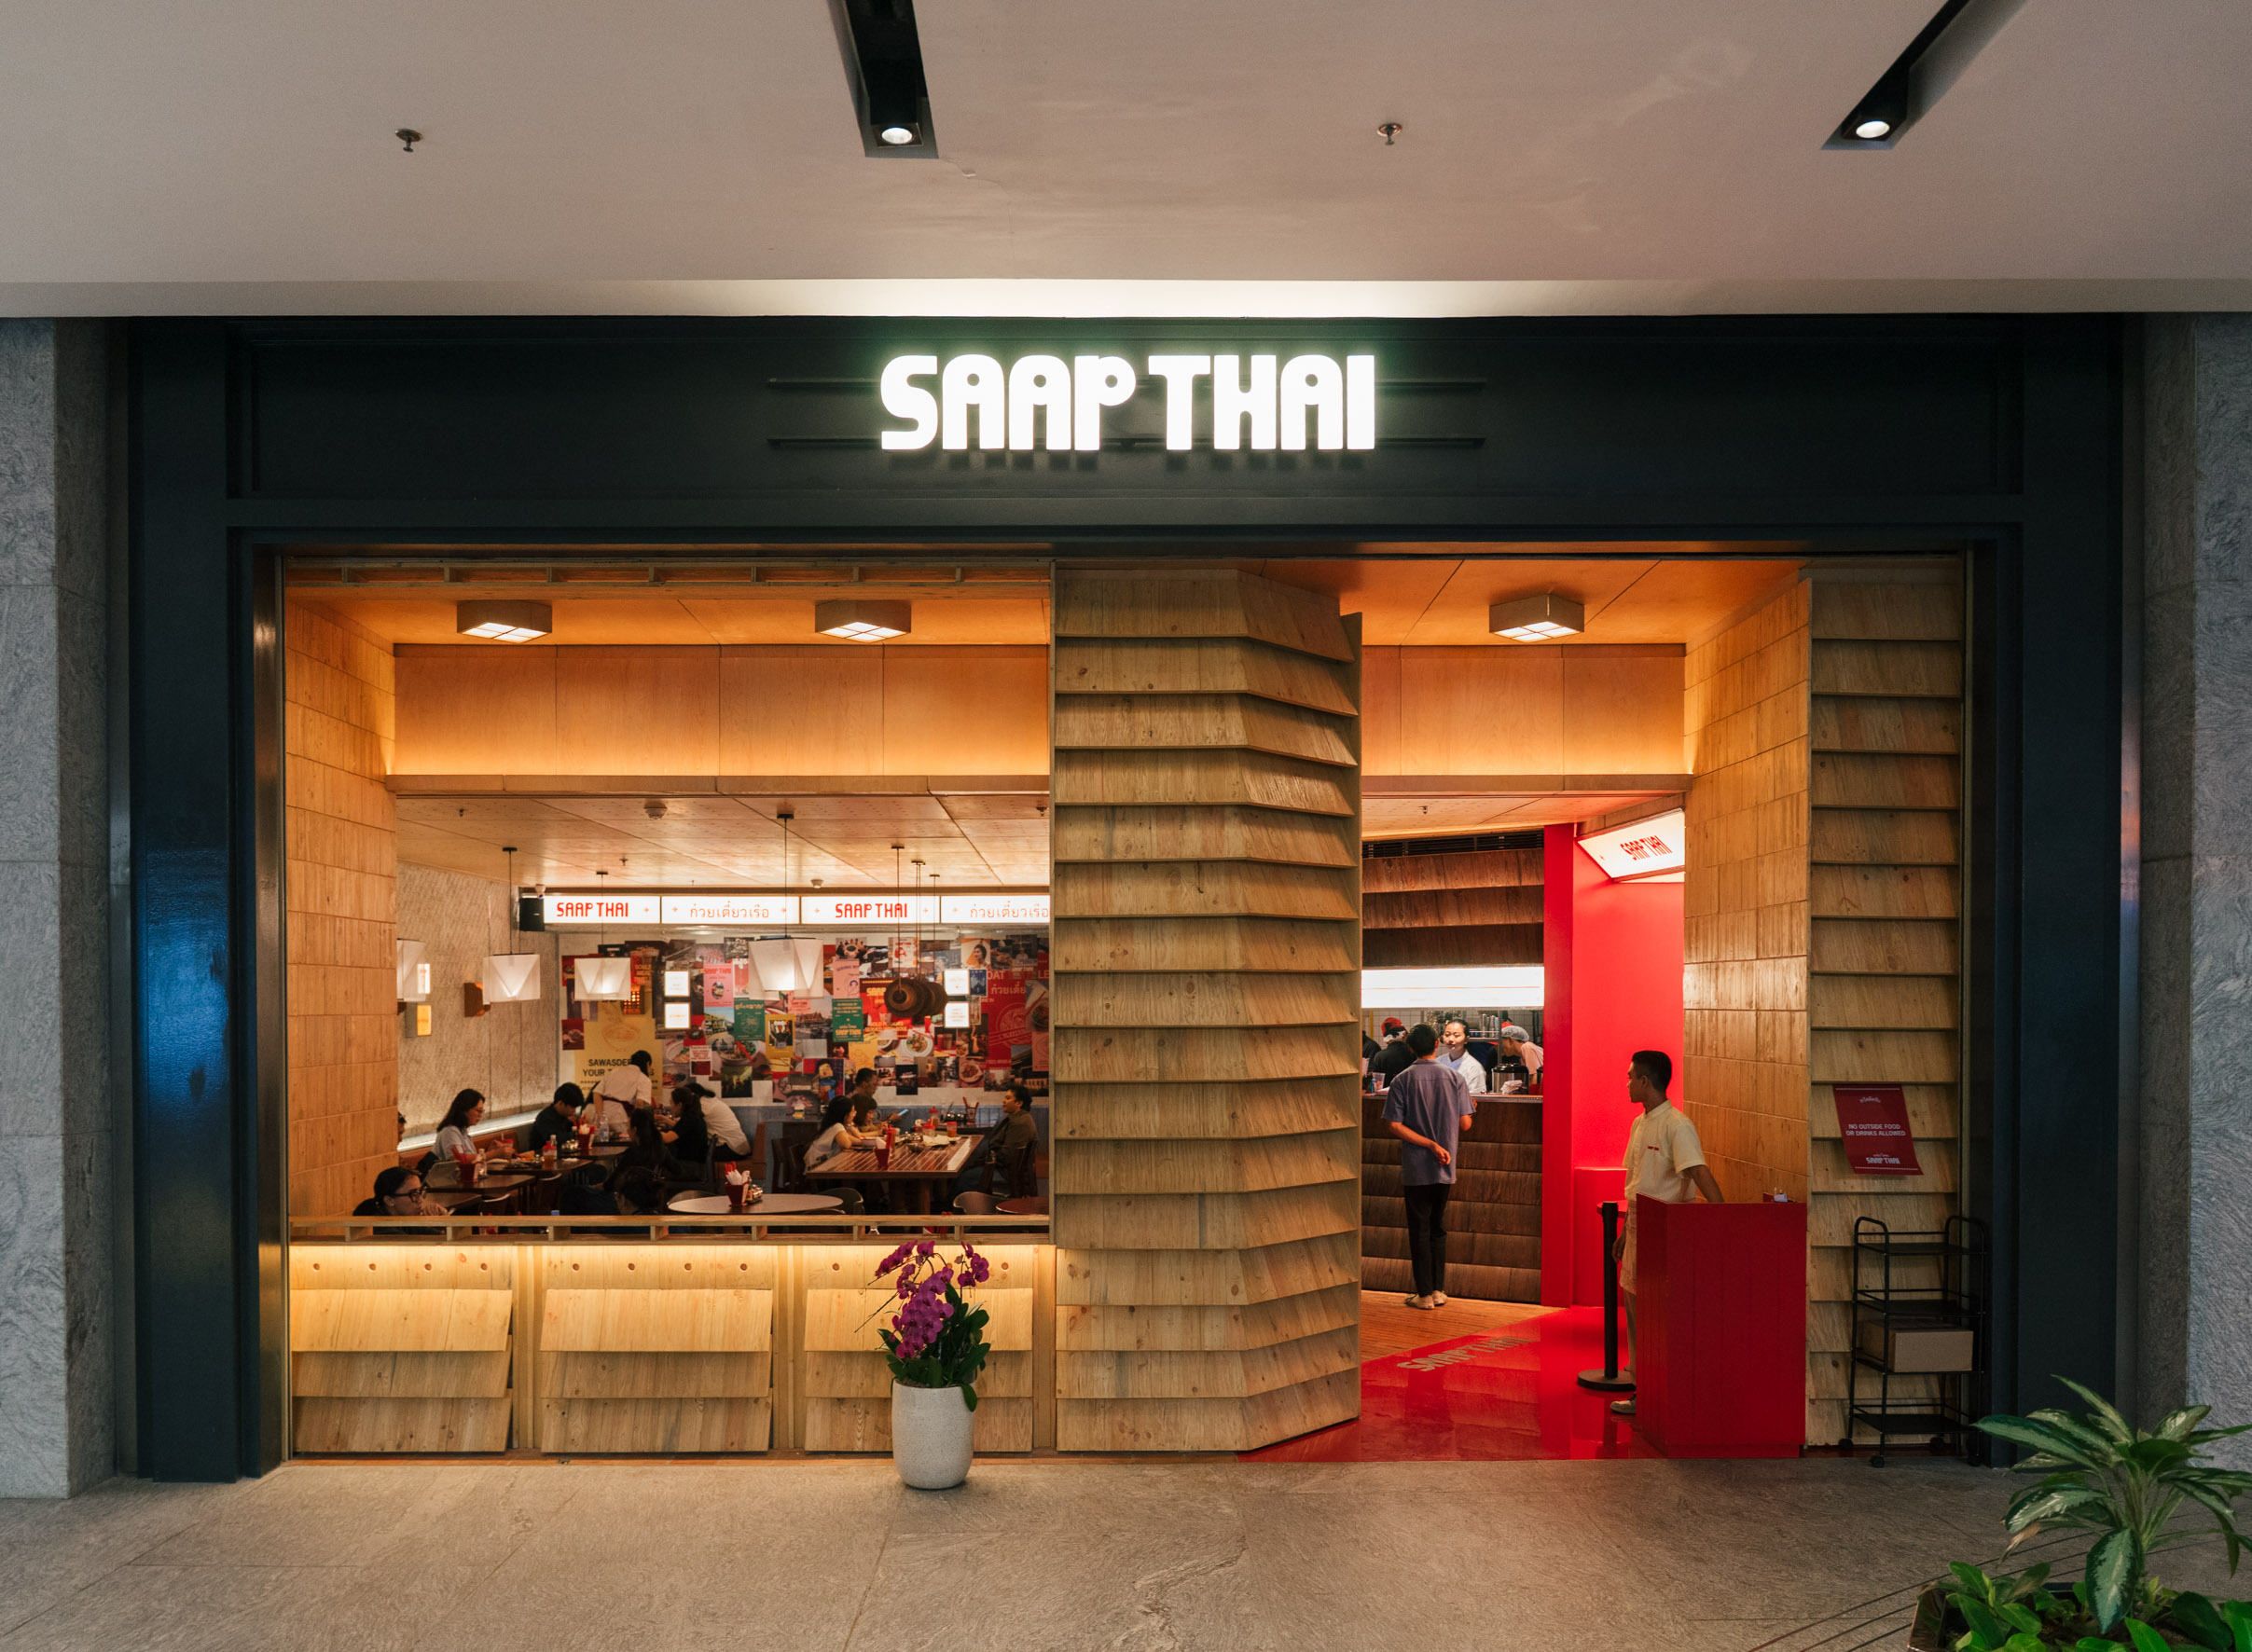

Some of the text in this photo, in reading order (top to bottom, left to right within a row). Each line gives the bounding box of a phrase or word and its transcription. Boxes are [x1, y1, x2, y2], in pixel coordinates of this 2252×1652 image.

[880, 354, 1375, 451] SAAP THAI
[1620, 835, 1673, 861] SAAP THAI
[557, 902, 629, 917] SAAP THAI
[835, 902, 908, 917] SAAP THAI
[582, 1068, 605, 1077] YOUR
[1397, 1336, 1536, 1372] SAAP THAI
